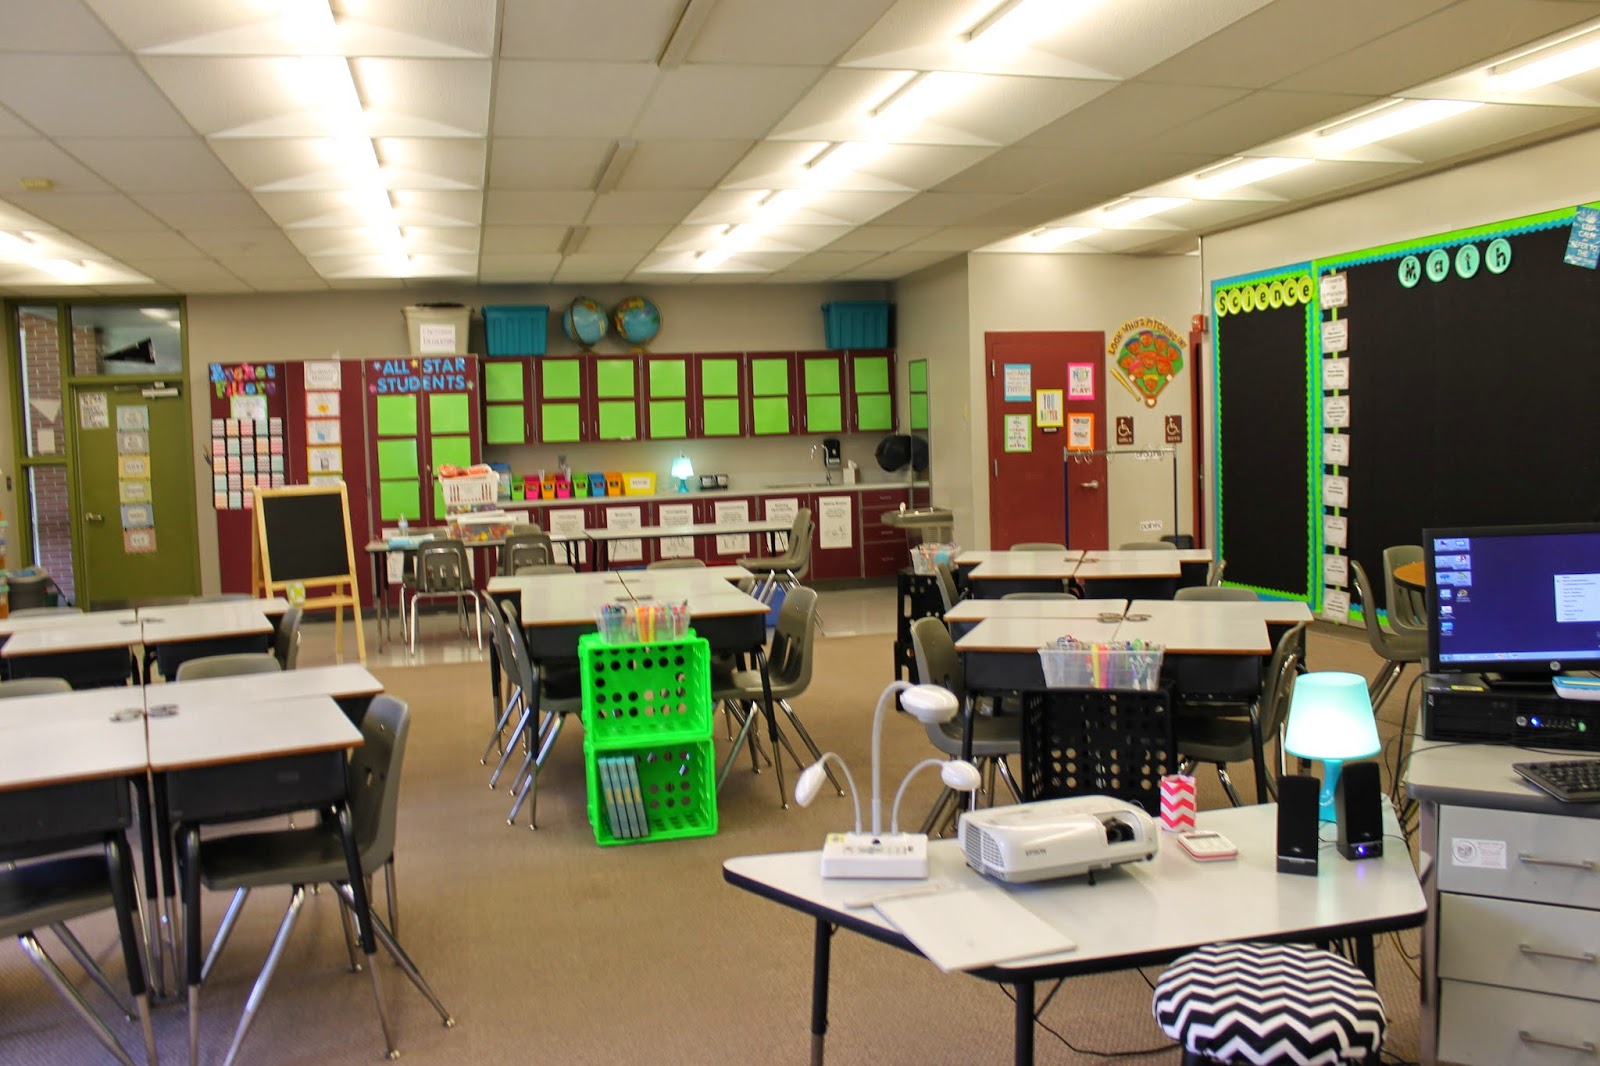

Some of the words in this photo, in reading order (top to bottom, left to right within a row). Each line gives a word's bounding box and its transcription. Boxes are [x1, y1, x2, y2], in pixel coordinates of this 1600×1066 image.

[1404, 247, 1506, 281] Math
[1219, 283, 1310, 312] Science
[1108, 331, 1123, 355] LOOK
[1121, 318, 1145, 333] WHO'S
[1145, 318, 1178, 342] PITCHING
[382, 359, 410, 376] ALL
[422, 357, 466, 374] STAR
[377, 374, 466, 393] STUDENTS
[1042, 394, 1056, 410] YOU
